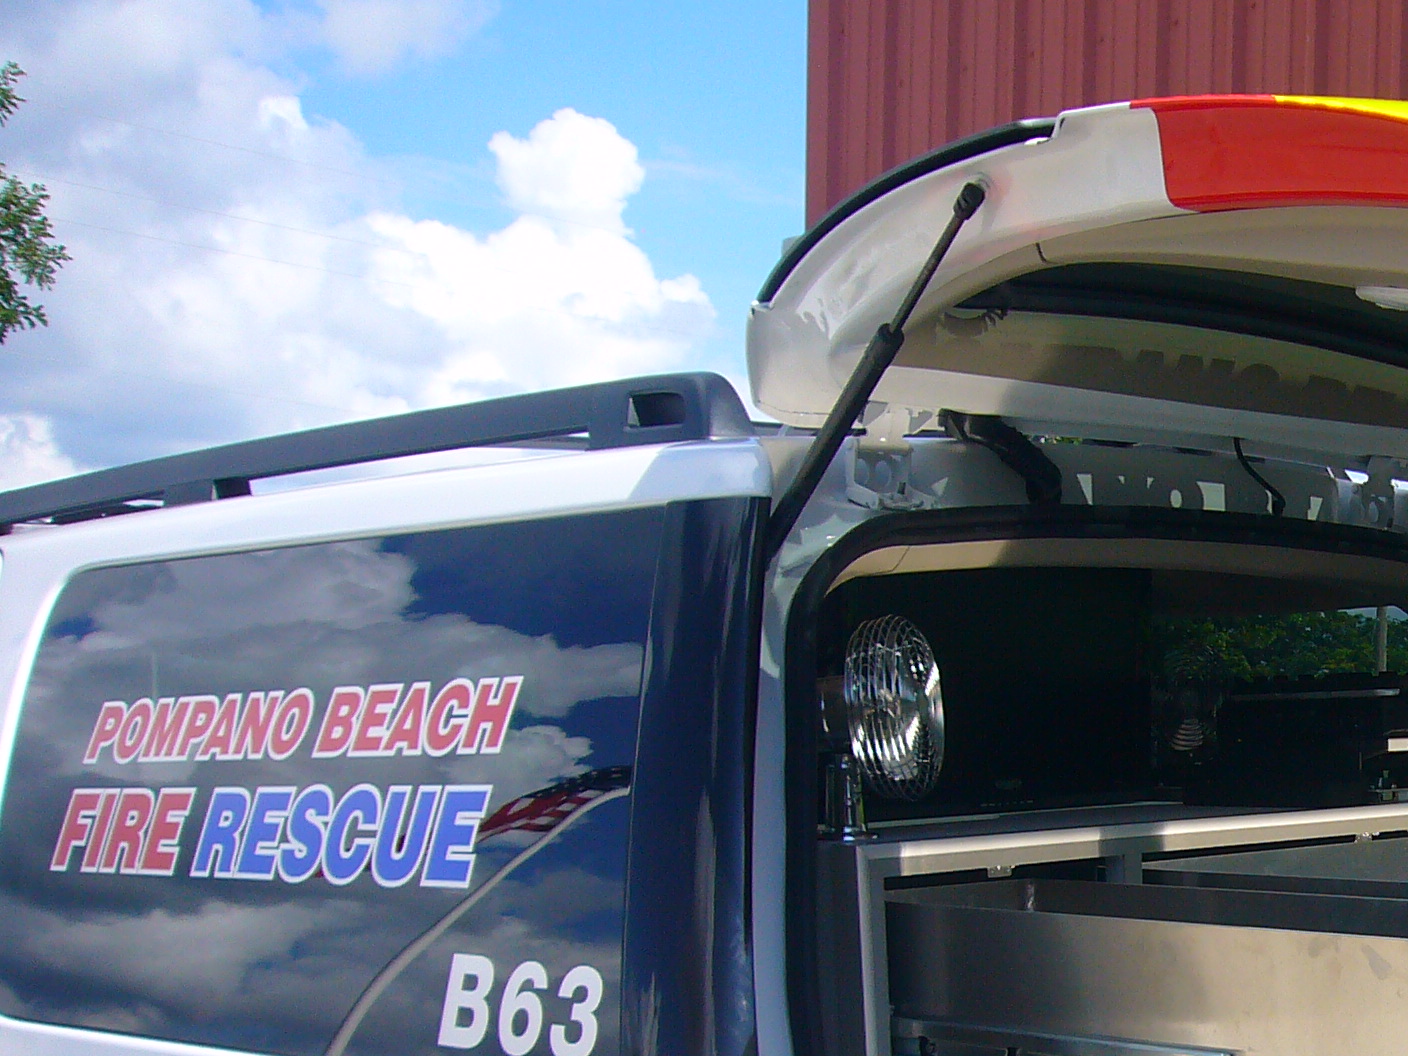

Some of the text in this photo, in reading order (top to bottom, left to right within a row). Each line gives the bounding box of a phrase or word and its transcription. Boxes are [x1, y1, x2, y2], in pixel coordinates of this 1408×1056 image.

[84, 676, 523, 764] POMPANO BEACH
[51, 784, 492, 887] FIRE RESCUE
